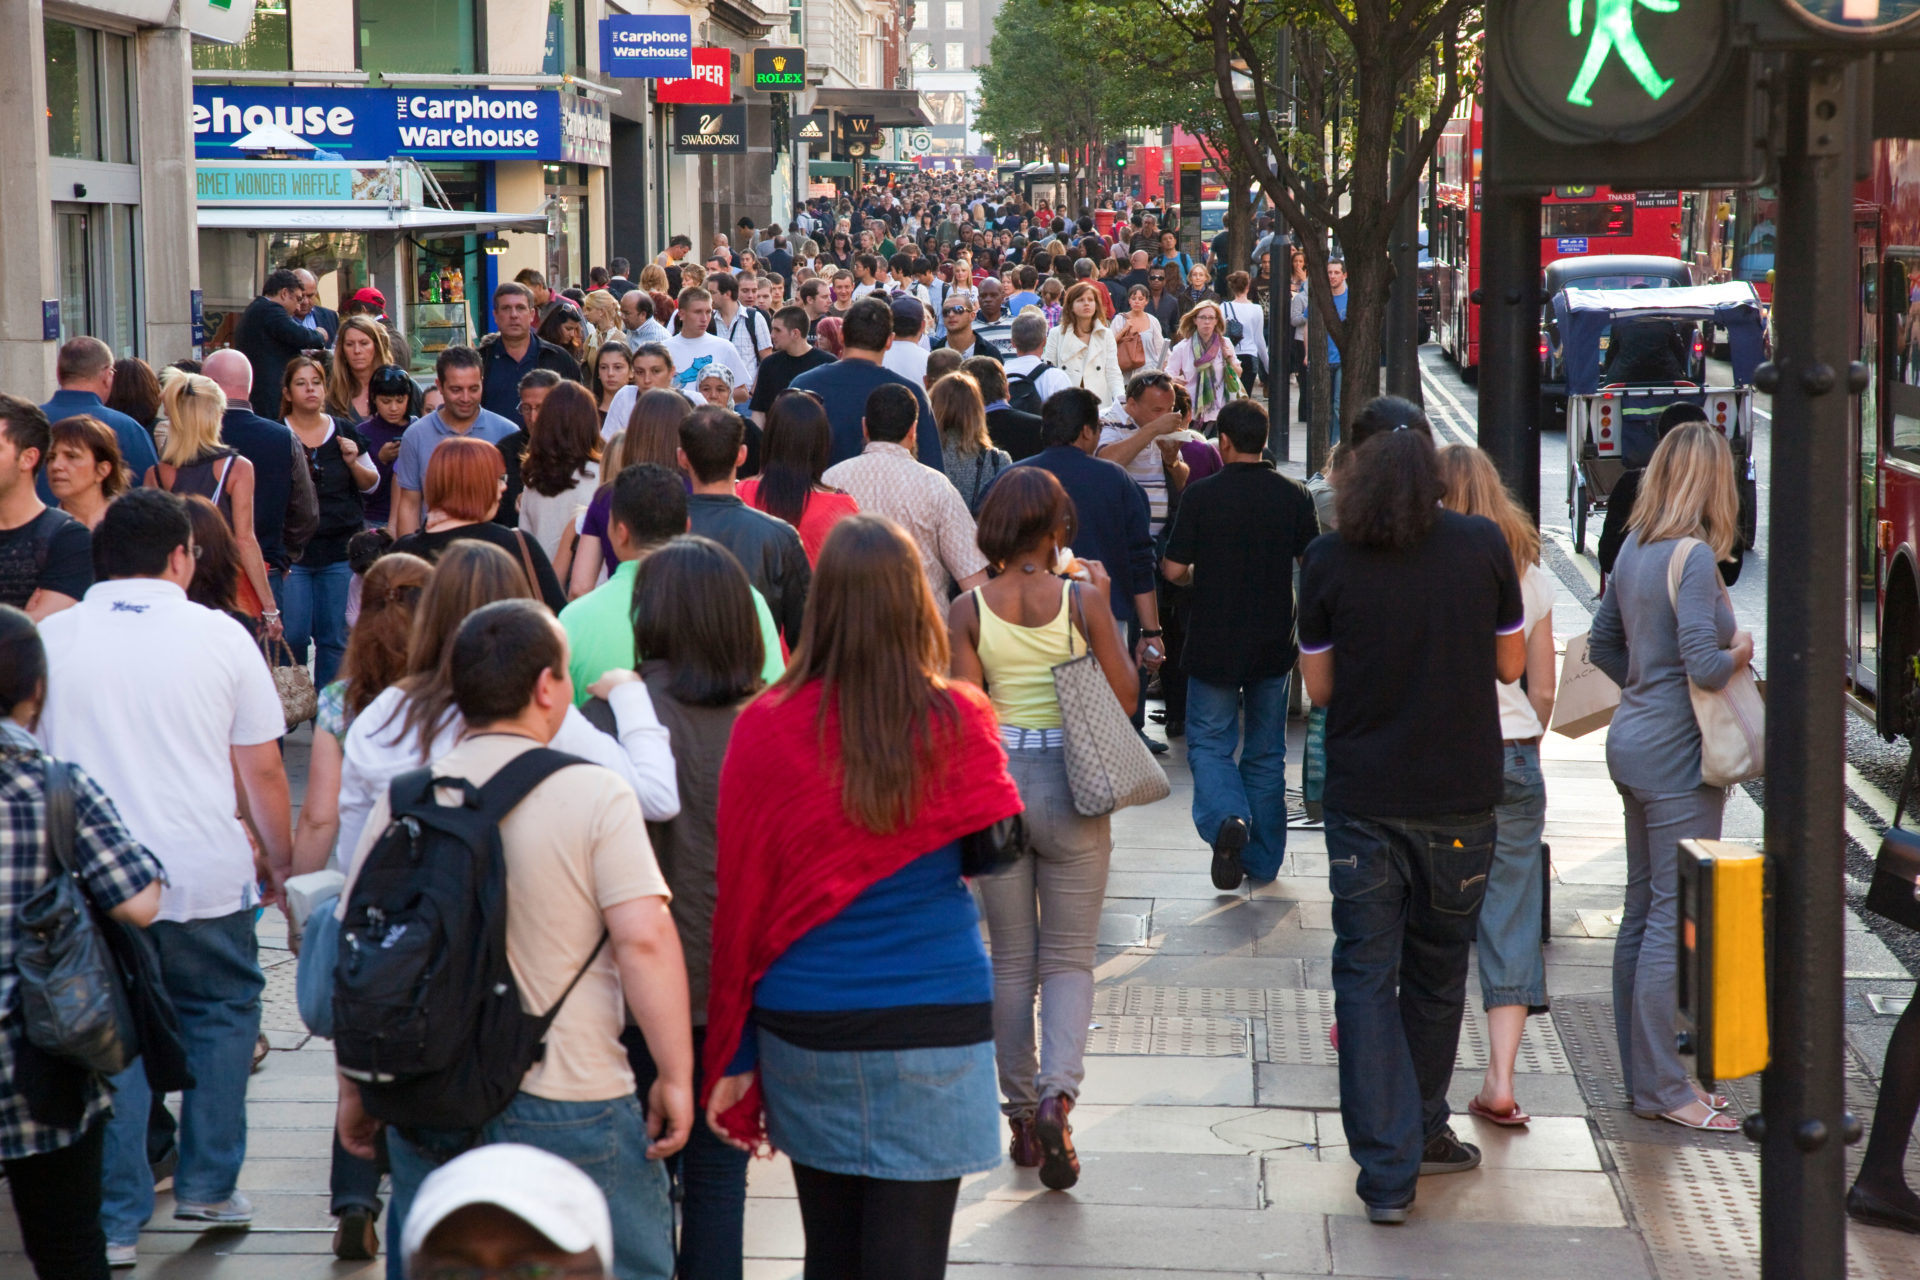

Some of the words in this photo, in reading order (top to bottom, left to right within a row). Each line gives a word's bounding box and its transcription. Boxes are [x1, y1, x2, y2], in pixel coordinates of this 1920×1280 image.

[619, 30, 687, 44] Carphone
[613, 46, 688, 57] Warehouse
[663, 65, 724, 87] PER
[756, 73, 803, 83] ROLEX
[397, 96, 407, 119] THE
[410, 95, 538, 123] Carphone
[852, 119, 870, 132] W
[398, 125, 539, 147] Warehouse
[681, 134, 740, 145] SWAROVSKI
[235, 173, 287, 195] WONDER
[292, 173, 341, 196] WAFFLE
